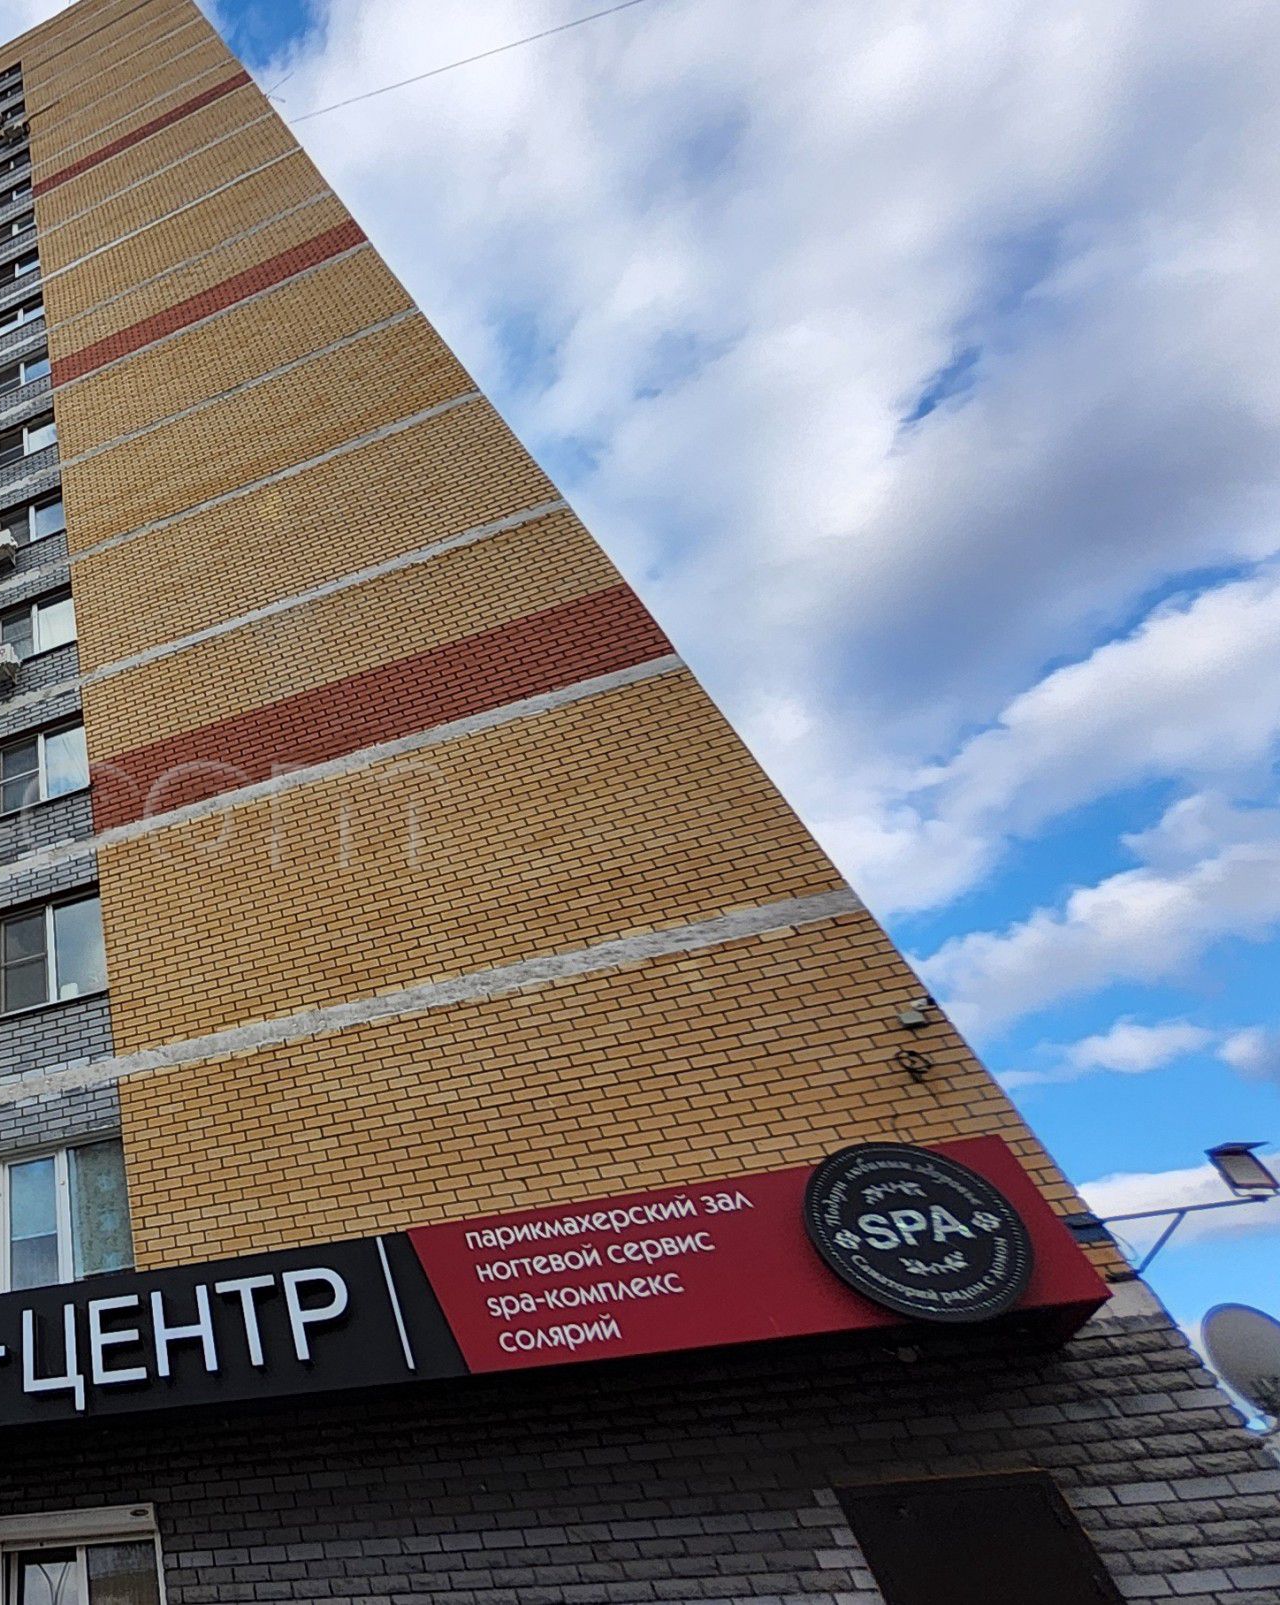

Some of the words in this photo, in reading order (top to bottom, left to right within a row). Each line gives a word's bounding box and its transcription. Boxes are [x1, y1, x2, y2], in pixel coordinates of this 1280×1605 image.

[464, 1194, 698, 1251] парикмахерский
[700, 1190, 754, 1214] зал
[857, 1204, 978, 1251] SPA
[475, 1243, 603, 1283] ногтевой
[606, 1231, 716, 1265] сервис
[487, 1273, 685, 1321] spa-комплекс
[499, 1313, 623, 1353] солярий
